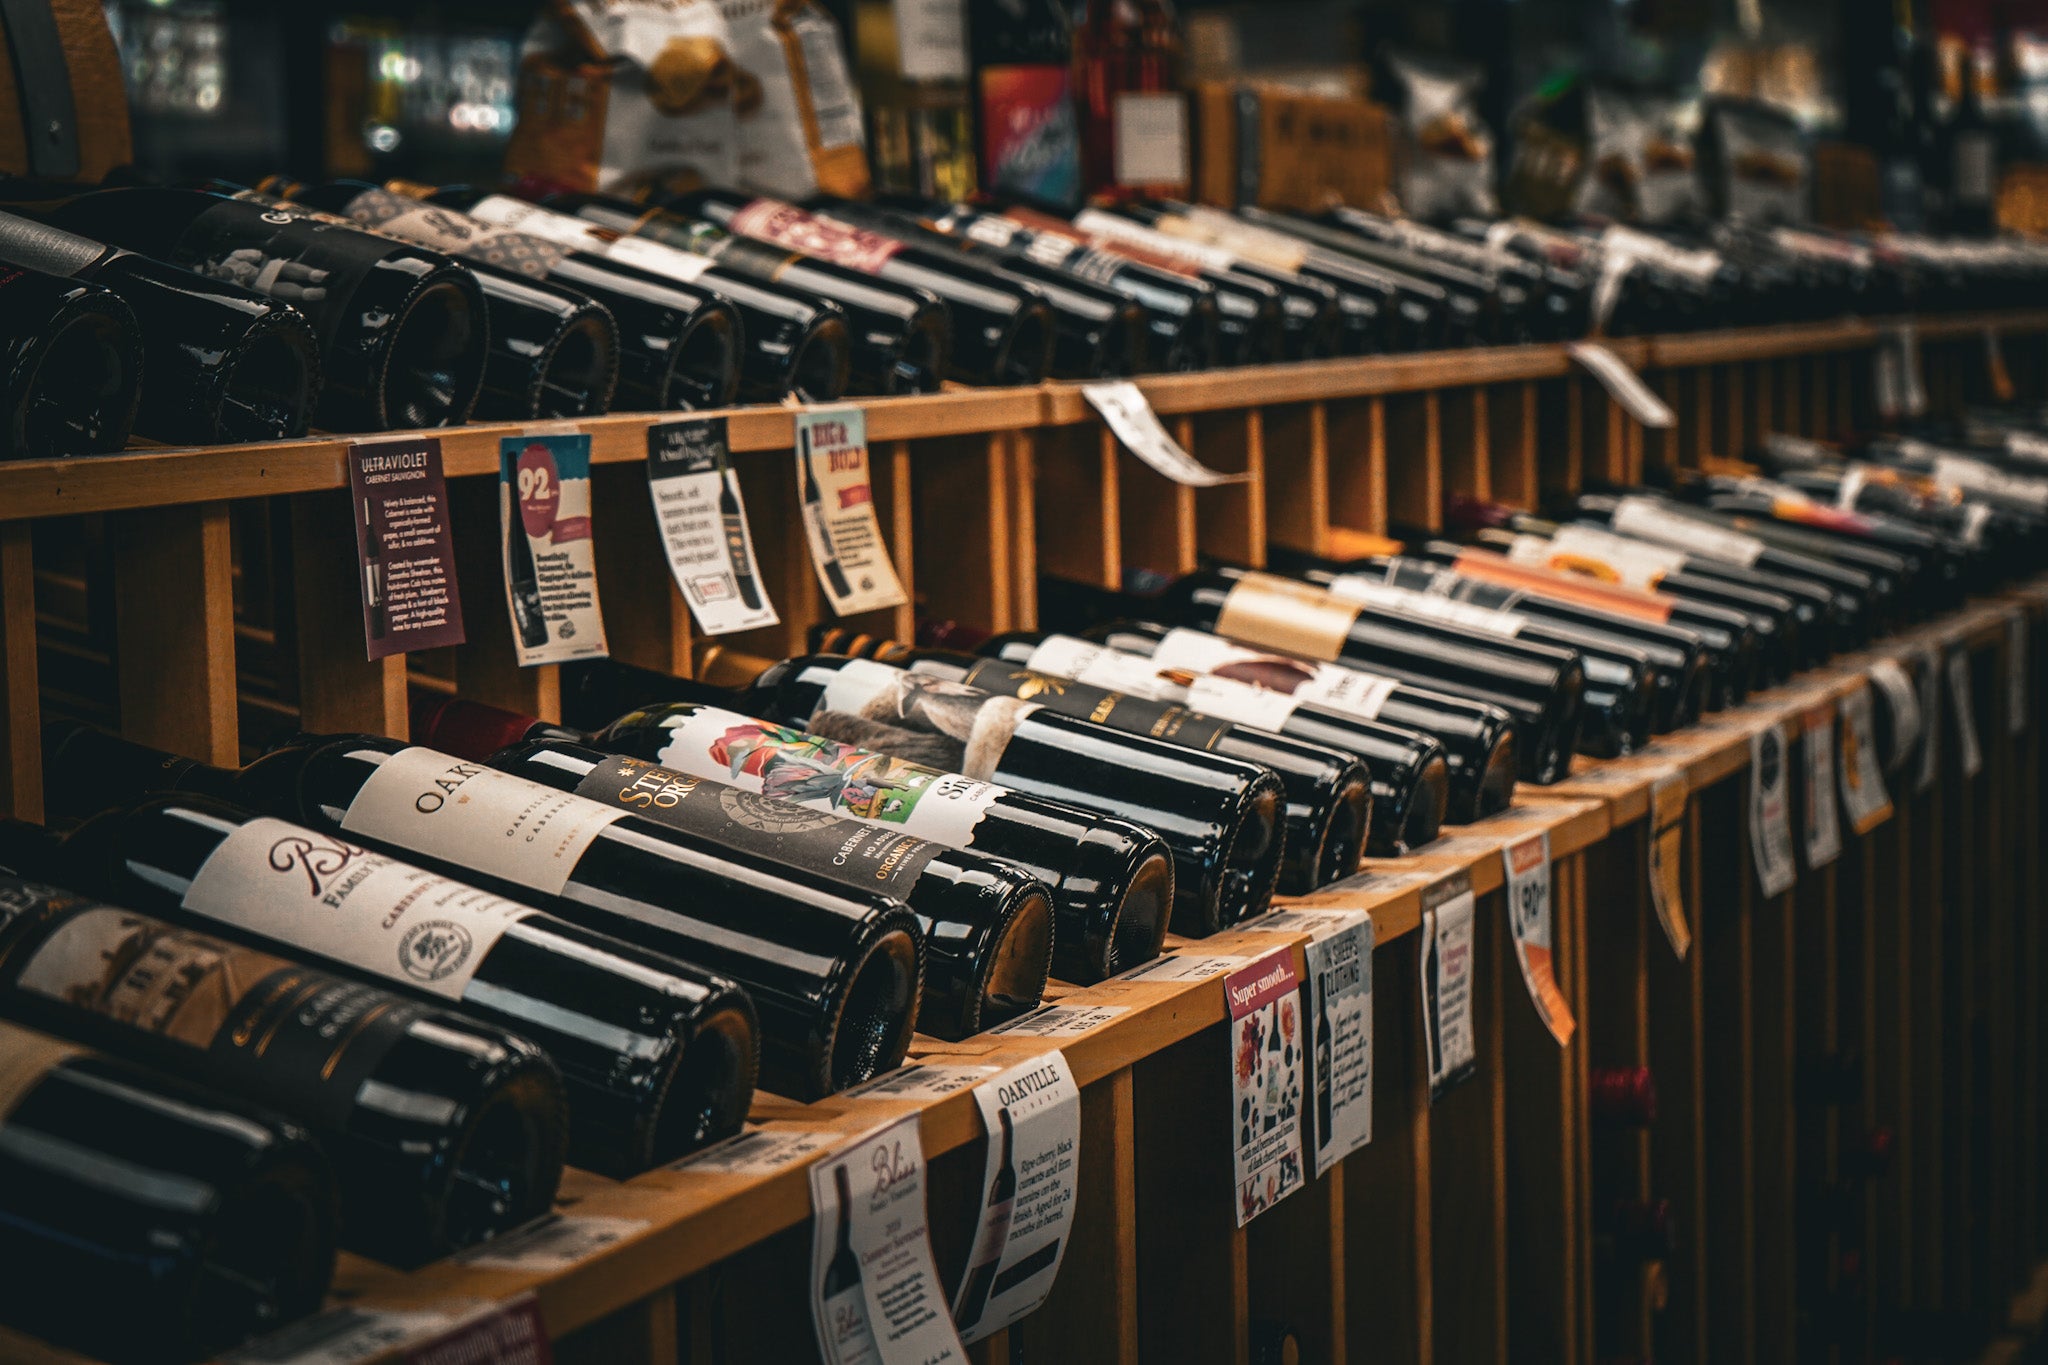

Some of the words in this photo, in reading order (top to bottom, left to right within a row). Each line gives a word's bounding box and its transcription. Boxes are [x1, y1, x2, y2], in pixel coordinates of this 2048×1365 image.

[361, 452, 428, 473] ULTRAVIOLET
[364, 472, 391, 485] CABERNET
[391, 470, 426, 482] SAUVIGNON
[518, 467, 551, 501] 92
[832, 827, 872, 866] CABERNET
[863, 846, 876, 858] NO
[875, 840, 911, 880] ORGANIC
[1231, 980, 1257, 1006] Super
[998, 1064, 1060, 1107] OAKVILLE
[871, 1140, 917, 1200] Bliss
[1021, 1158, 1035, 1176] Ripe
[1057, 1138, 1073, 1156] black
[1018, 1171, 1045, 1191] currants
[1045, 1165, 1058, 1180] and
[1058, 1158, 1072, 1174] firm
[1016, 1189, 1041, 1208] tannins
[1041, 1185, 1050, 1198] on
[1050, 1179, 1061, 1193] the
[1034, 1198, 1052, 1219] Aged
[1052, 1193, 1062, 1209] for
[1062, 1187, 1072, 1203] 24
[1009, 1221, 1036, 1241] months
[1043, 1206, 1065, 1227] barrel.
